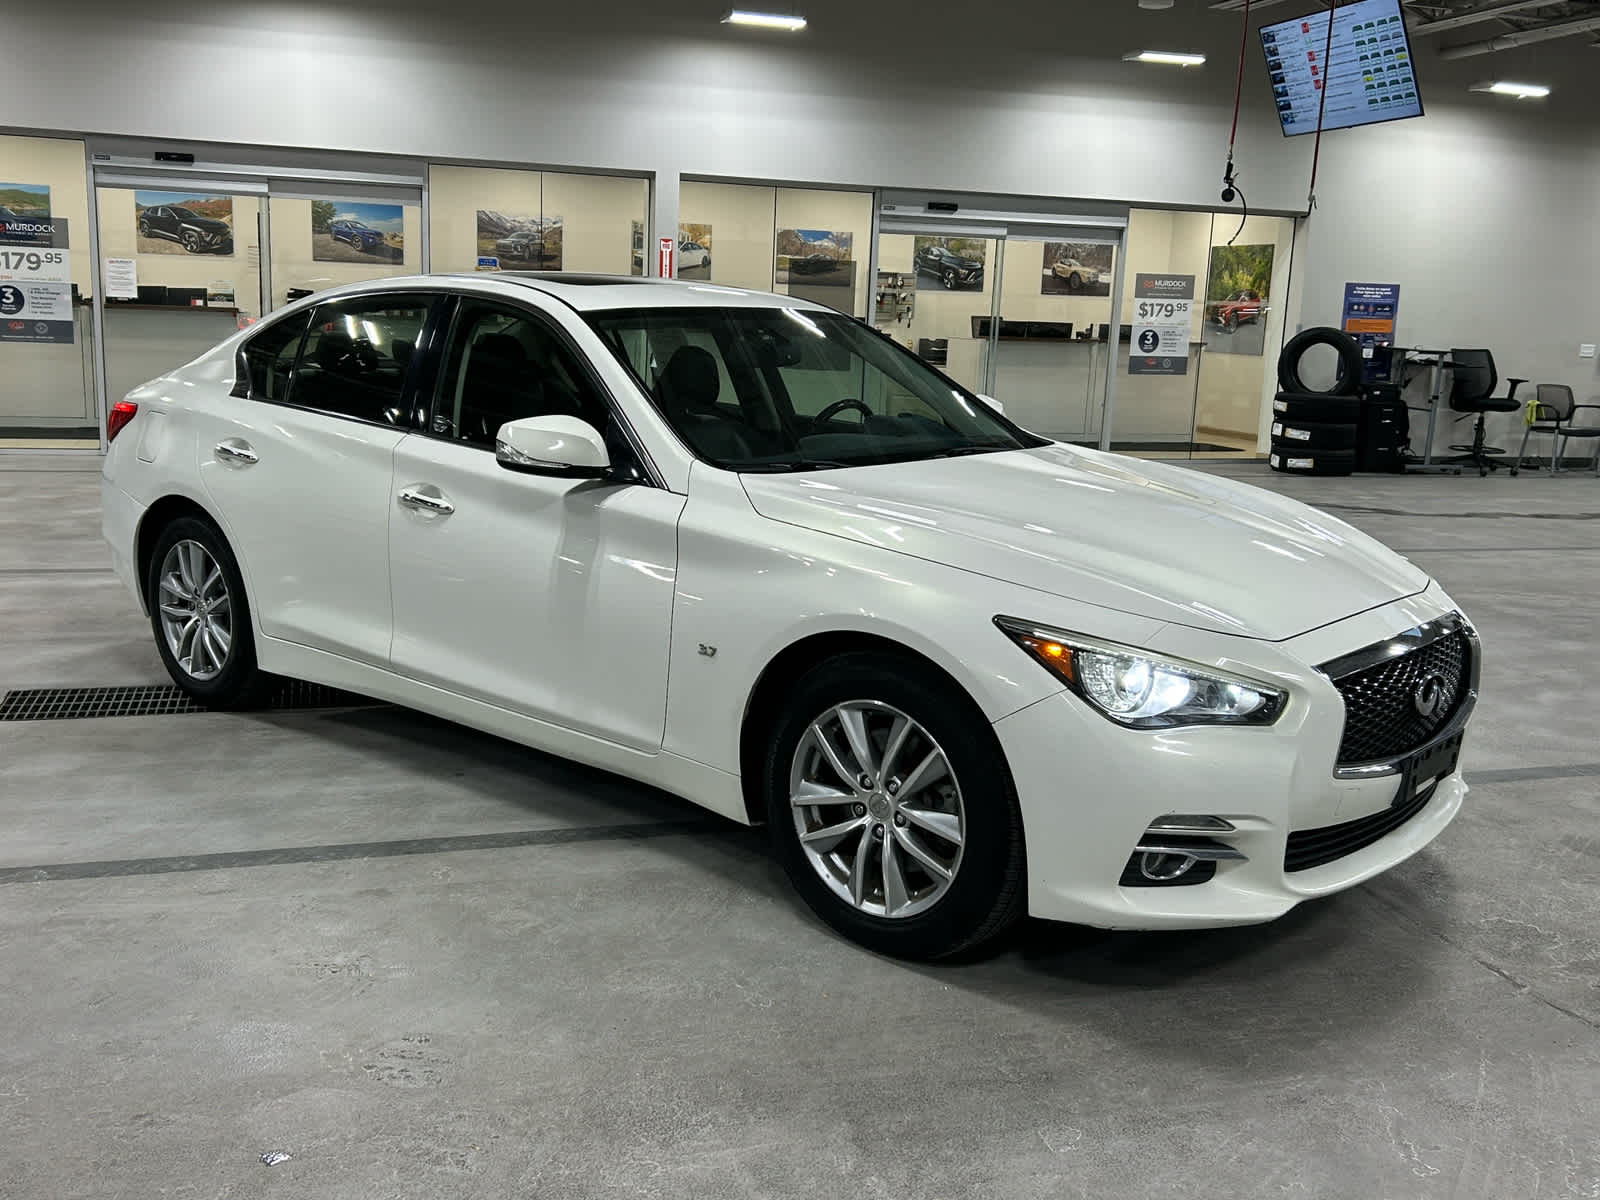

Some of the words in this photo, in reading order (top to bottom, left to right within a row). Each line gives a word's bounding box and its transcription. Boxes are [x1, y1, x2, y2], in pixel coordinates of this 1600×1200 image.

[5, 222, 56, 233] MURDOCK
[0, 251, 63, 271] 179.95
[1, 287, 15, 304] 3
[1138, 301, 1188, 319] $179.95
[1144, 331, 1154, 345] 3
